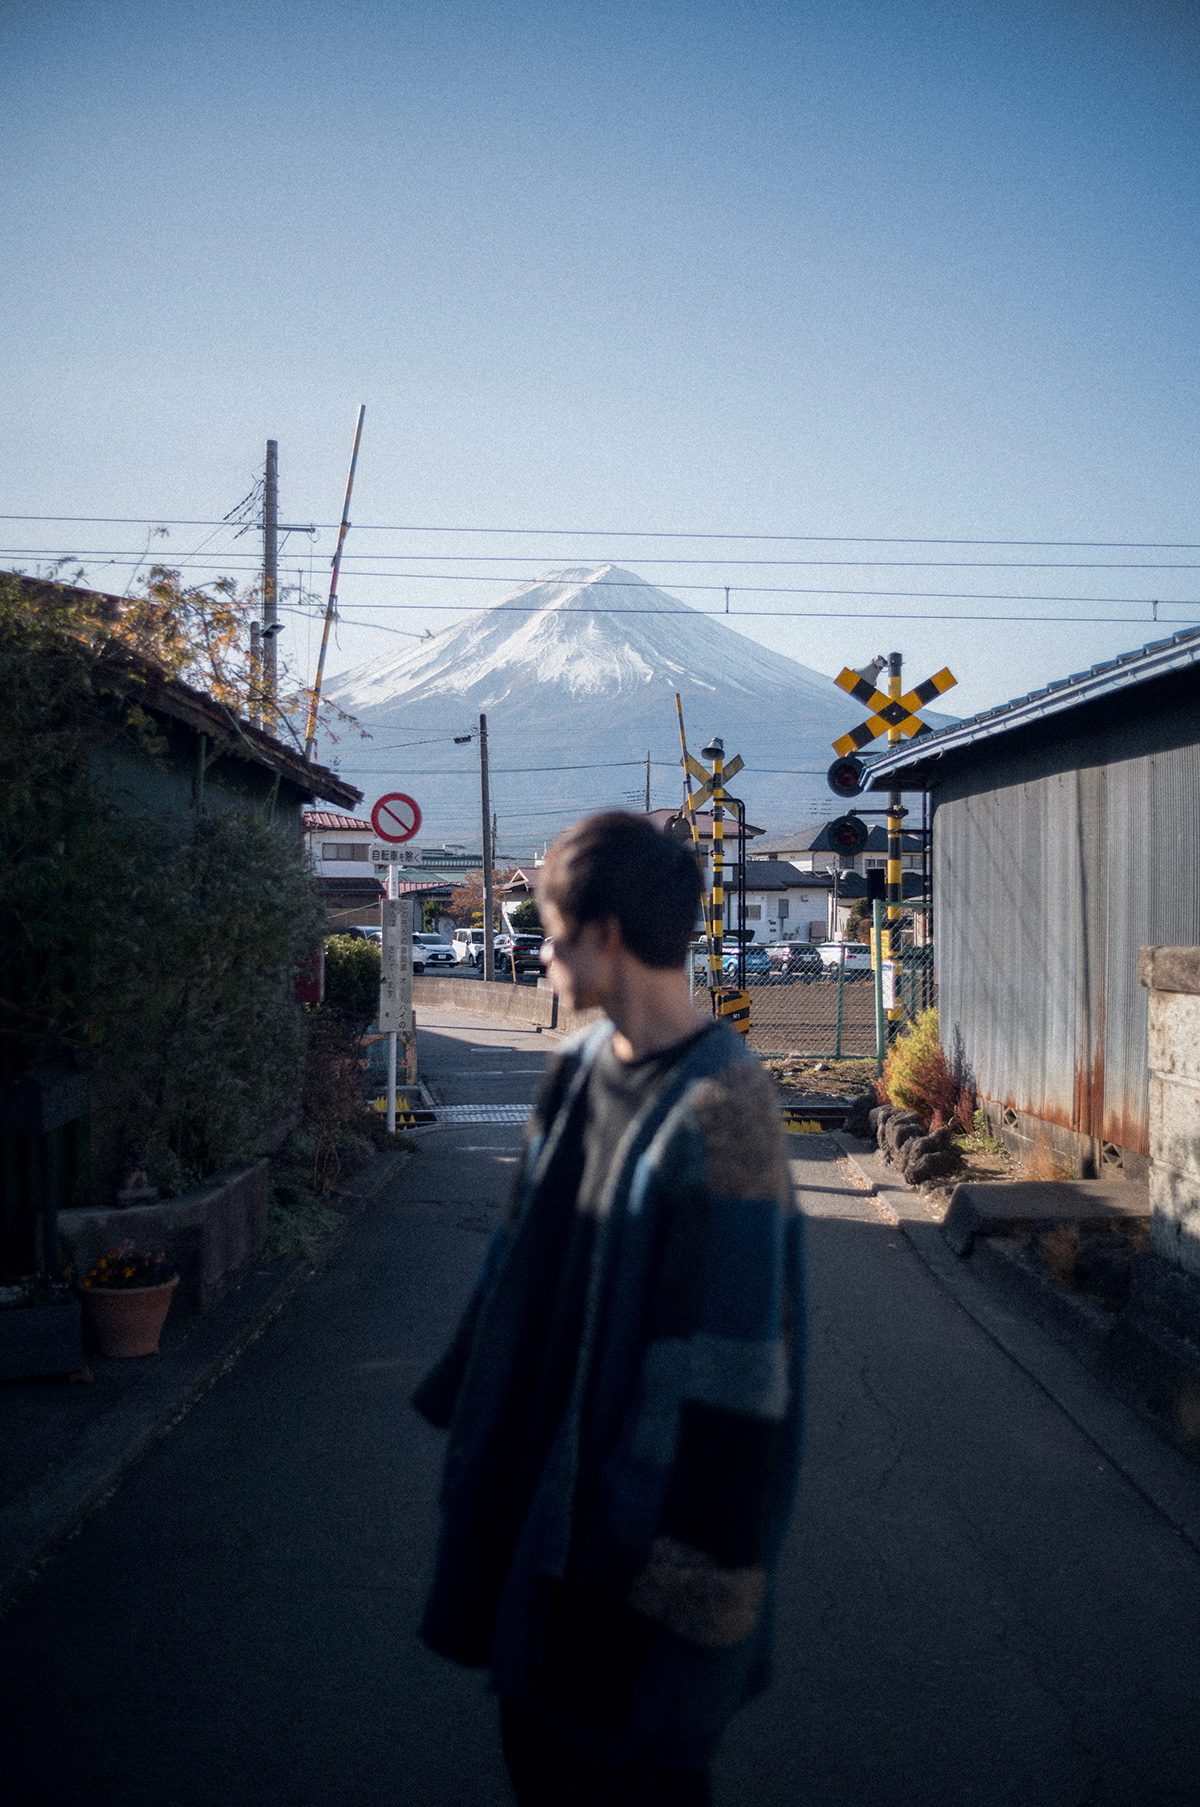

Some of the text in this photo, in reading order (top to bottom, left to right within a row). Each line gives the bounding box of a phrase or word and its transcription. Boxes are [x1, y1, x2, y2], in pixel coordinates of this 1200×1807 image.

[372, 849, 420, 863] 自転車を除く
